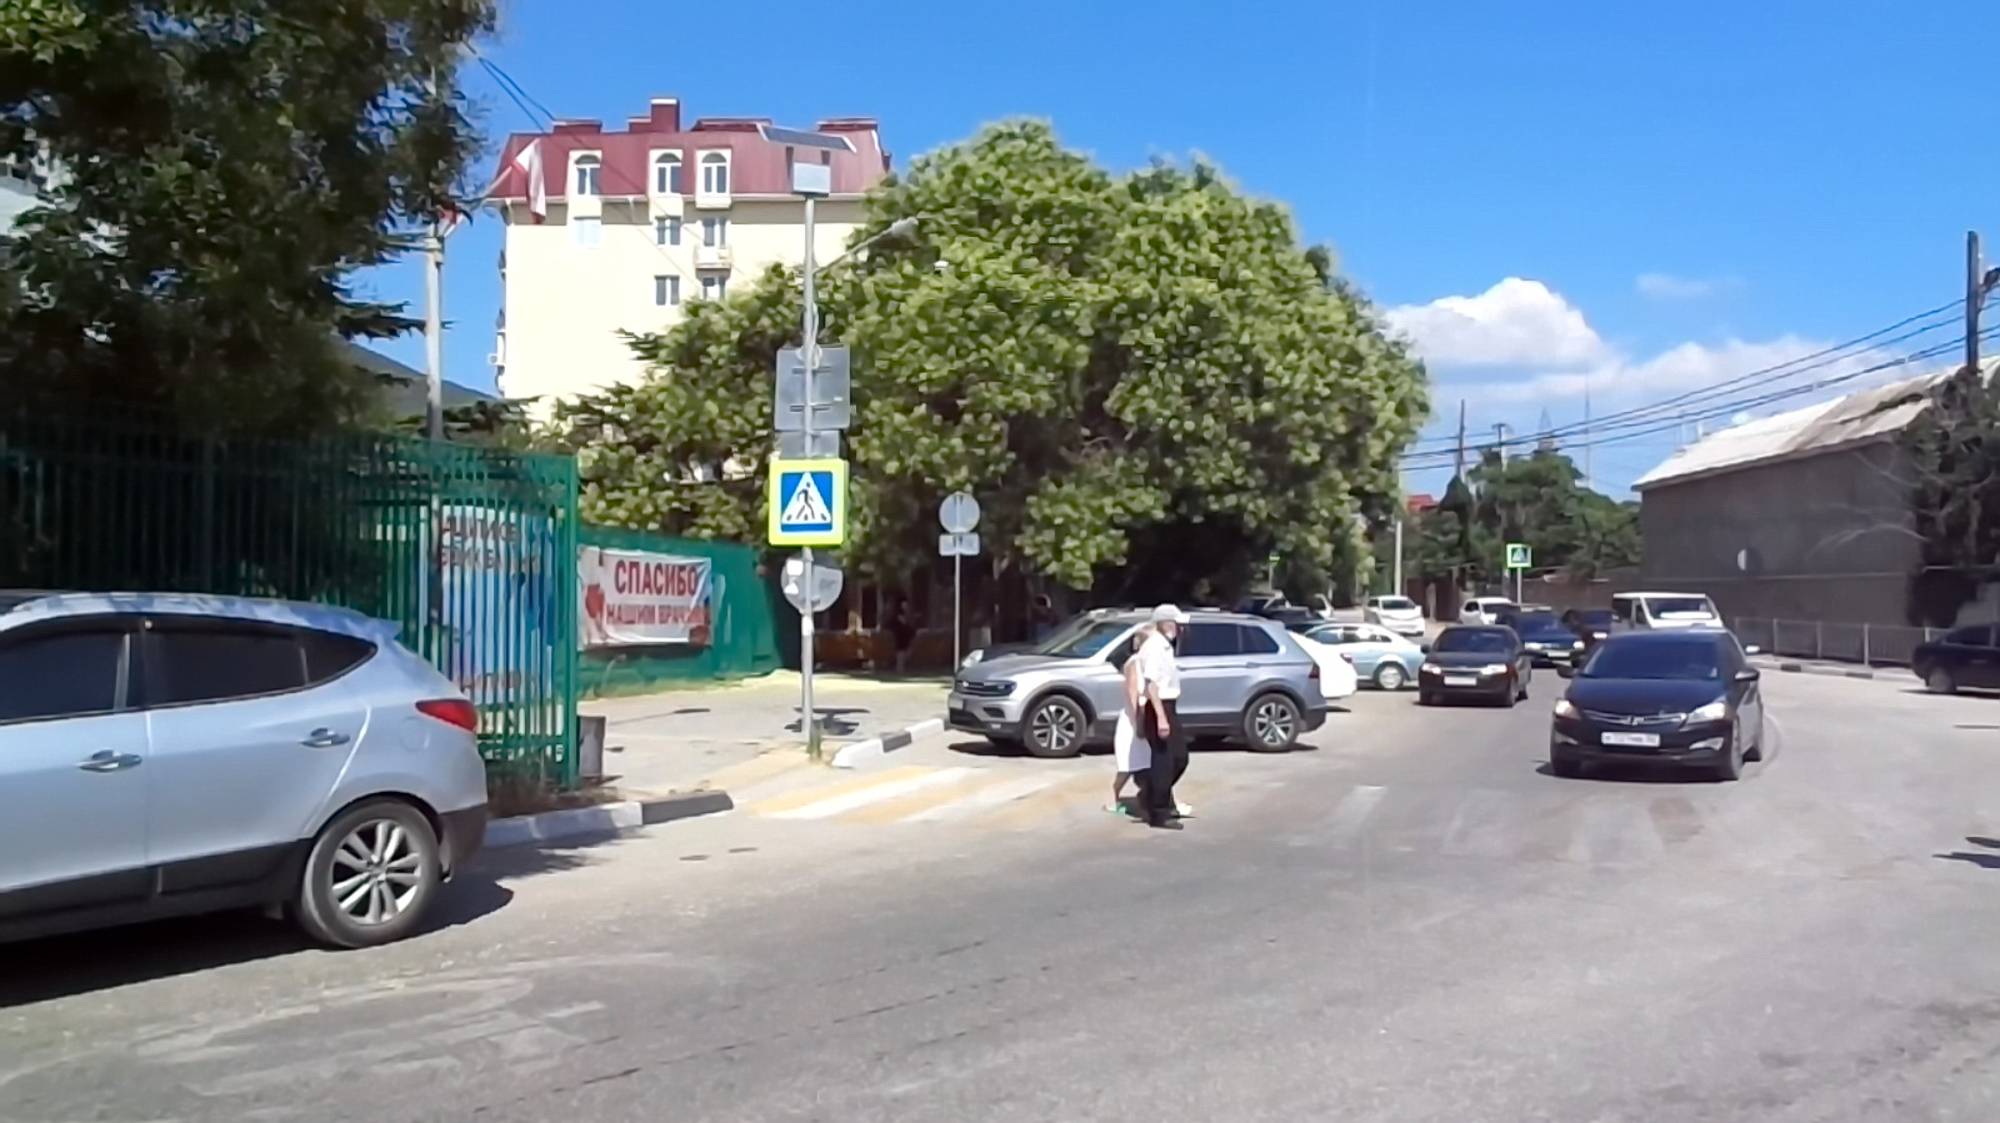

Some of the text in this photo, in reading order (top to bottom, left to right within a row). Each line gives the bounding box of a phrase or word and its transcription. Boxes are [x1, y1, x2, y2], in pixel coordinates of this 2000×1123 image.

[614, 559, 698, 597] СПАСИБО
[606, 603, 708, 625] НАШИМ ВРАЧ
